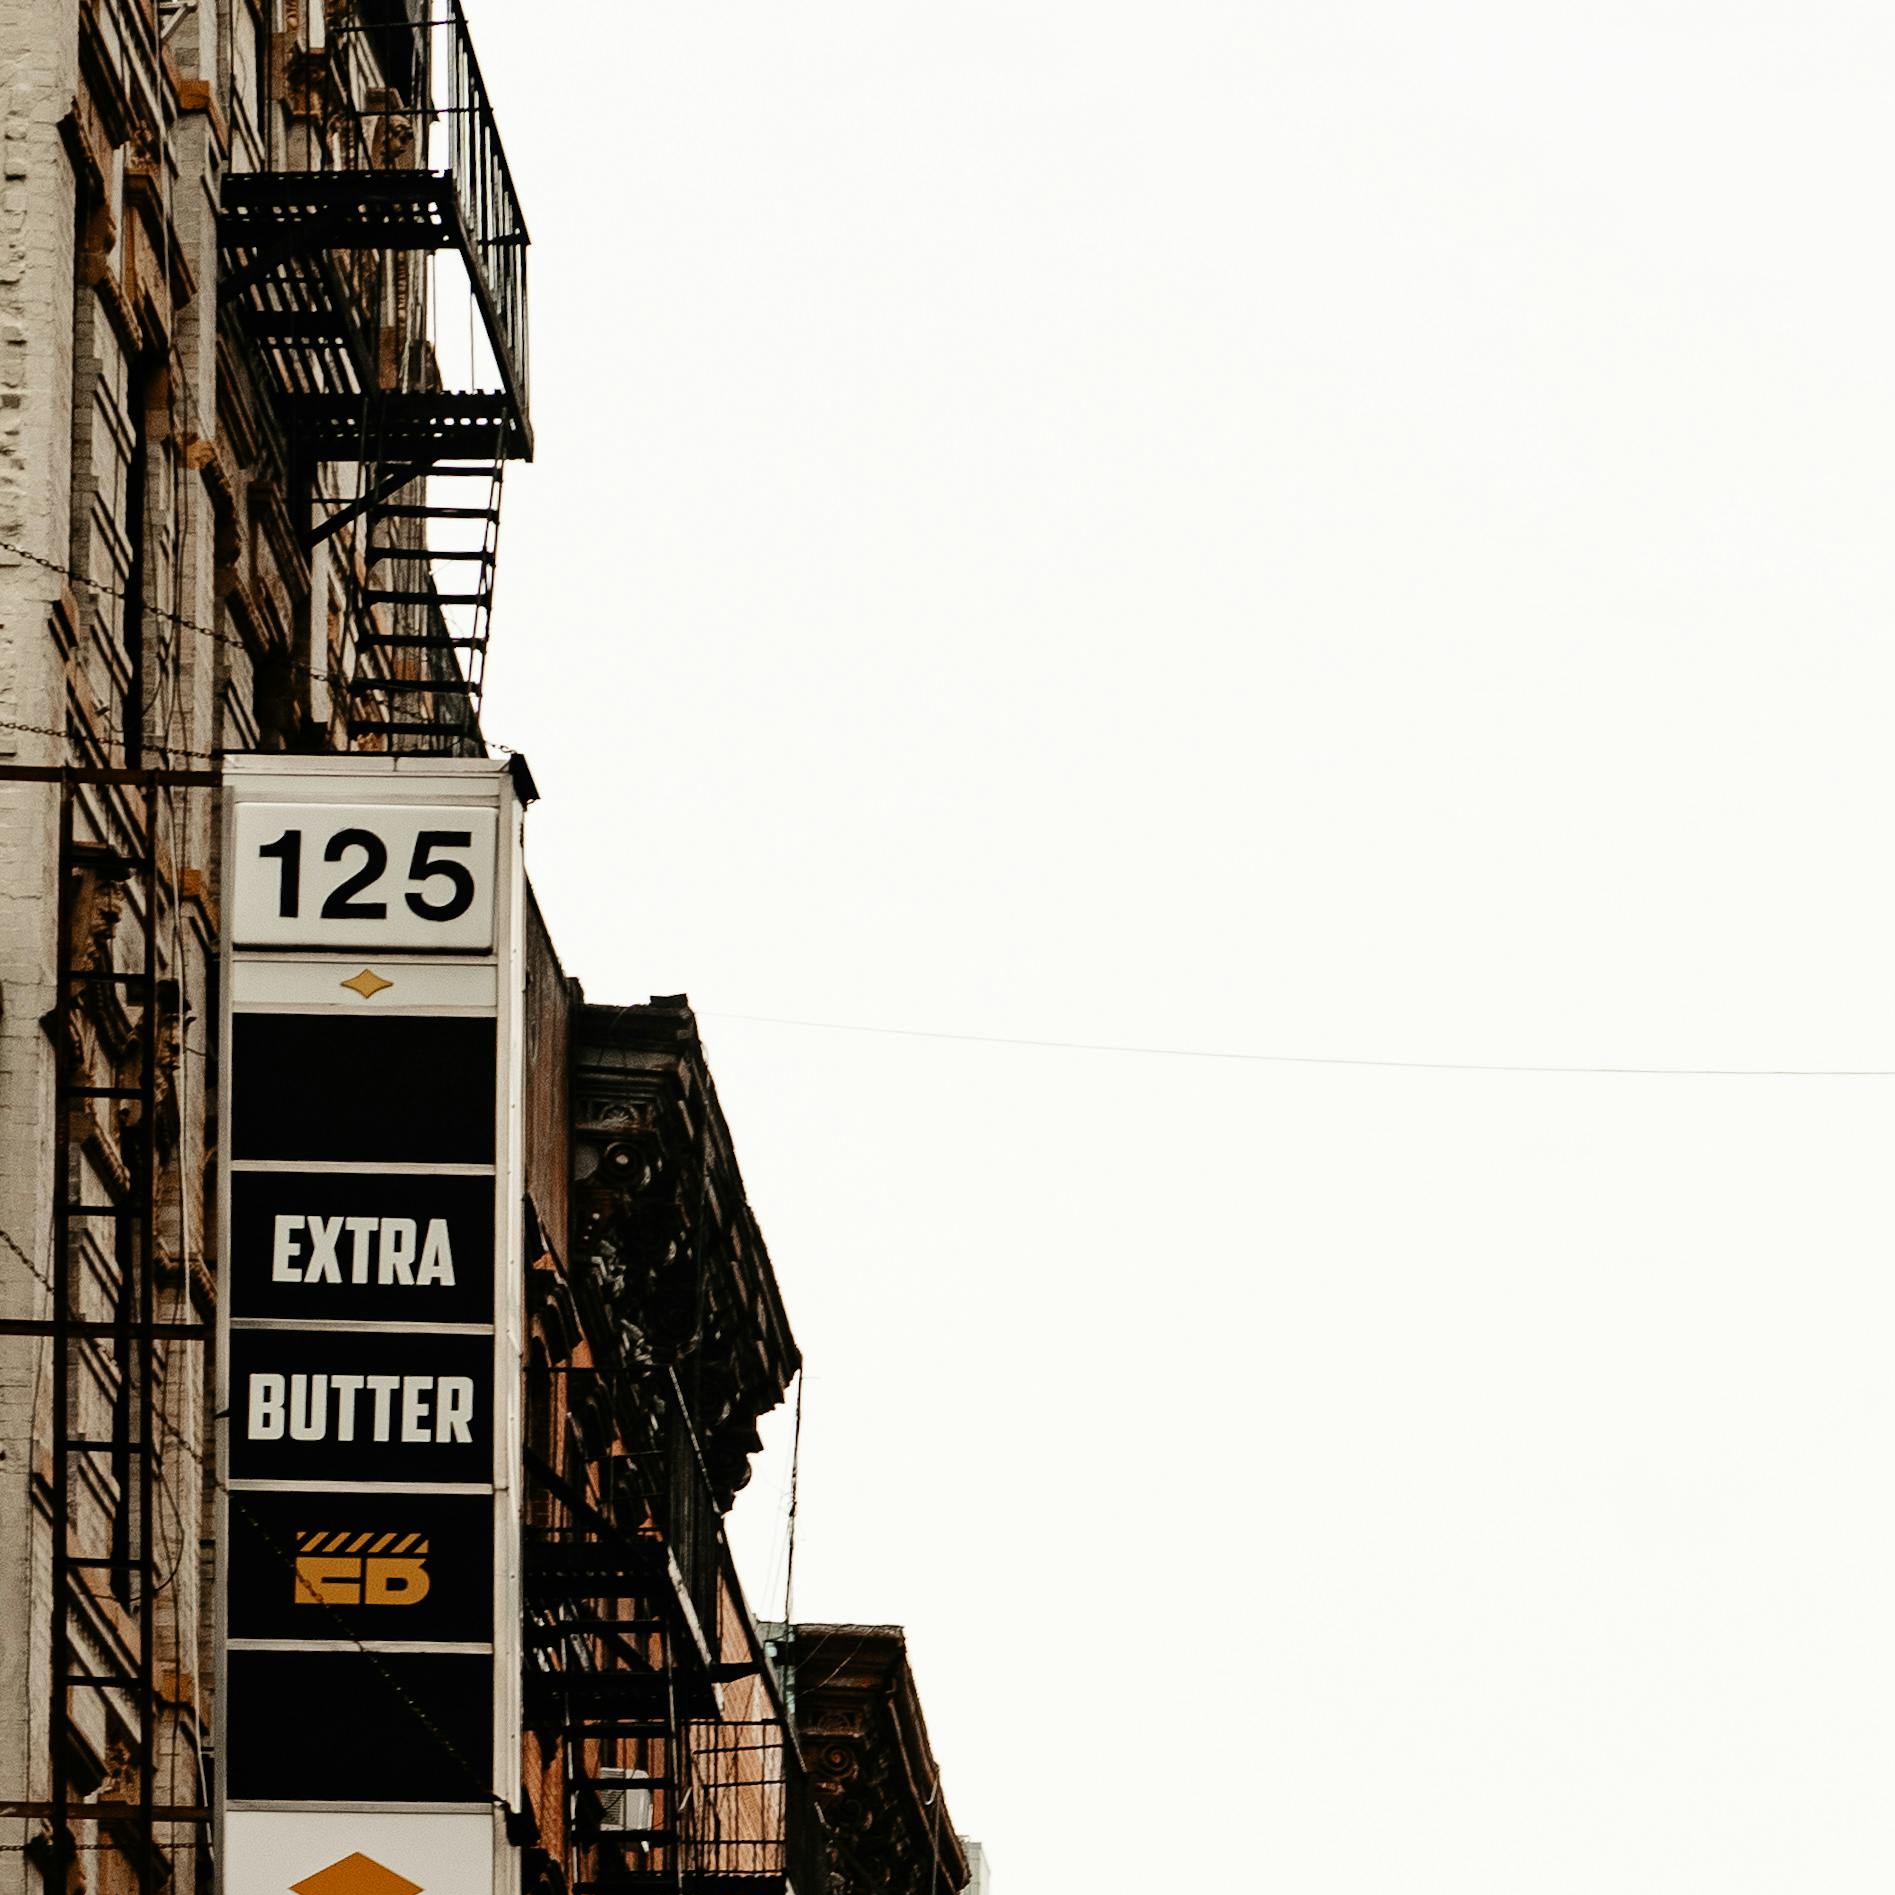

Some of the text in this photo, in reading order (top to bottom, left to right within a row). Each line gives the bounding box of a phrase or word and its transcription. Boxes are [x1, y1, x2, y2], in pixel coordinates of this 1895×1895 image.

[259, 829, 476, 922] 125
[272, 1213, 456, 1288] EXTRA
[247, 1372, 474, 1444] BUTTER
